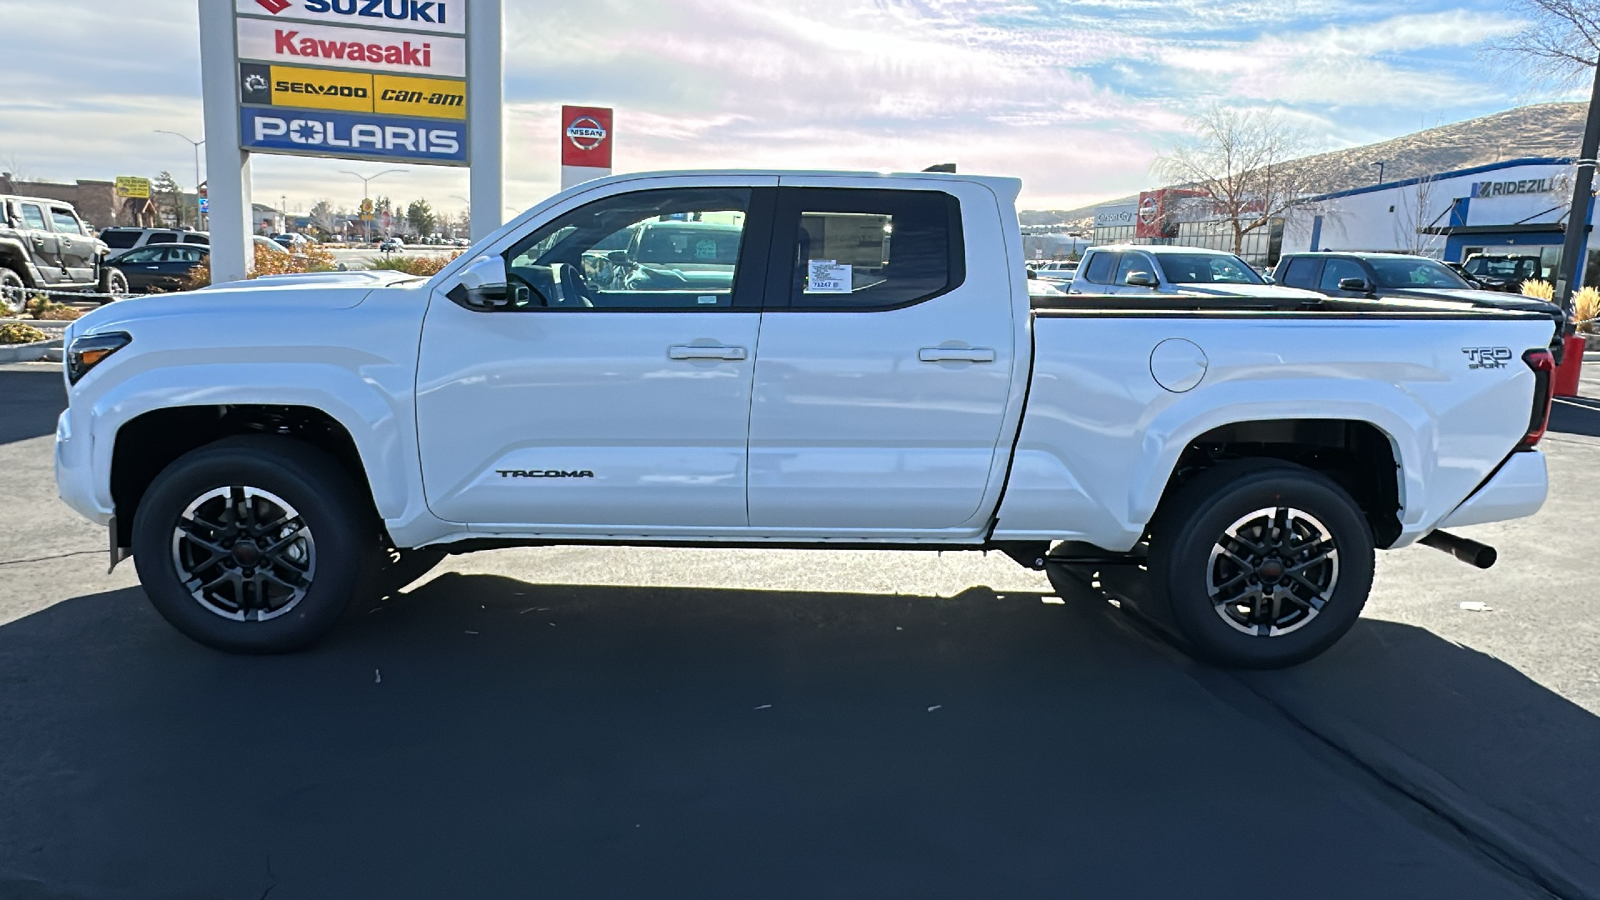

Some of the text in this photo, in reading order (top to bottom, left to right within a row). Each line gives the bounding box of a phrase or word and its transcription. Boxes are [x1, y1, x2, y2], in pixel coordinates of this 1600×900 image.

[304, 0, 446, 24] SUZUKI
[274, 29, 431, 67] Kawasaki
[254, 116, 460, 154] POLARIS
[570, 129, 603, 137] NISSAN
[1461, 347, 1512, 363] TRD
[1468, 362, 1507, 370] SPORT
[495, 469, 594, 478] TACOMA
